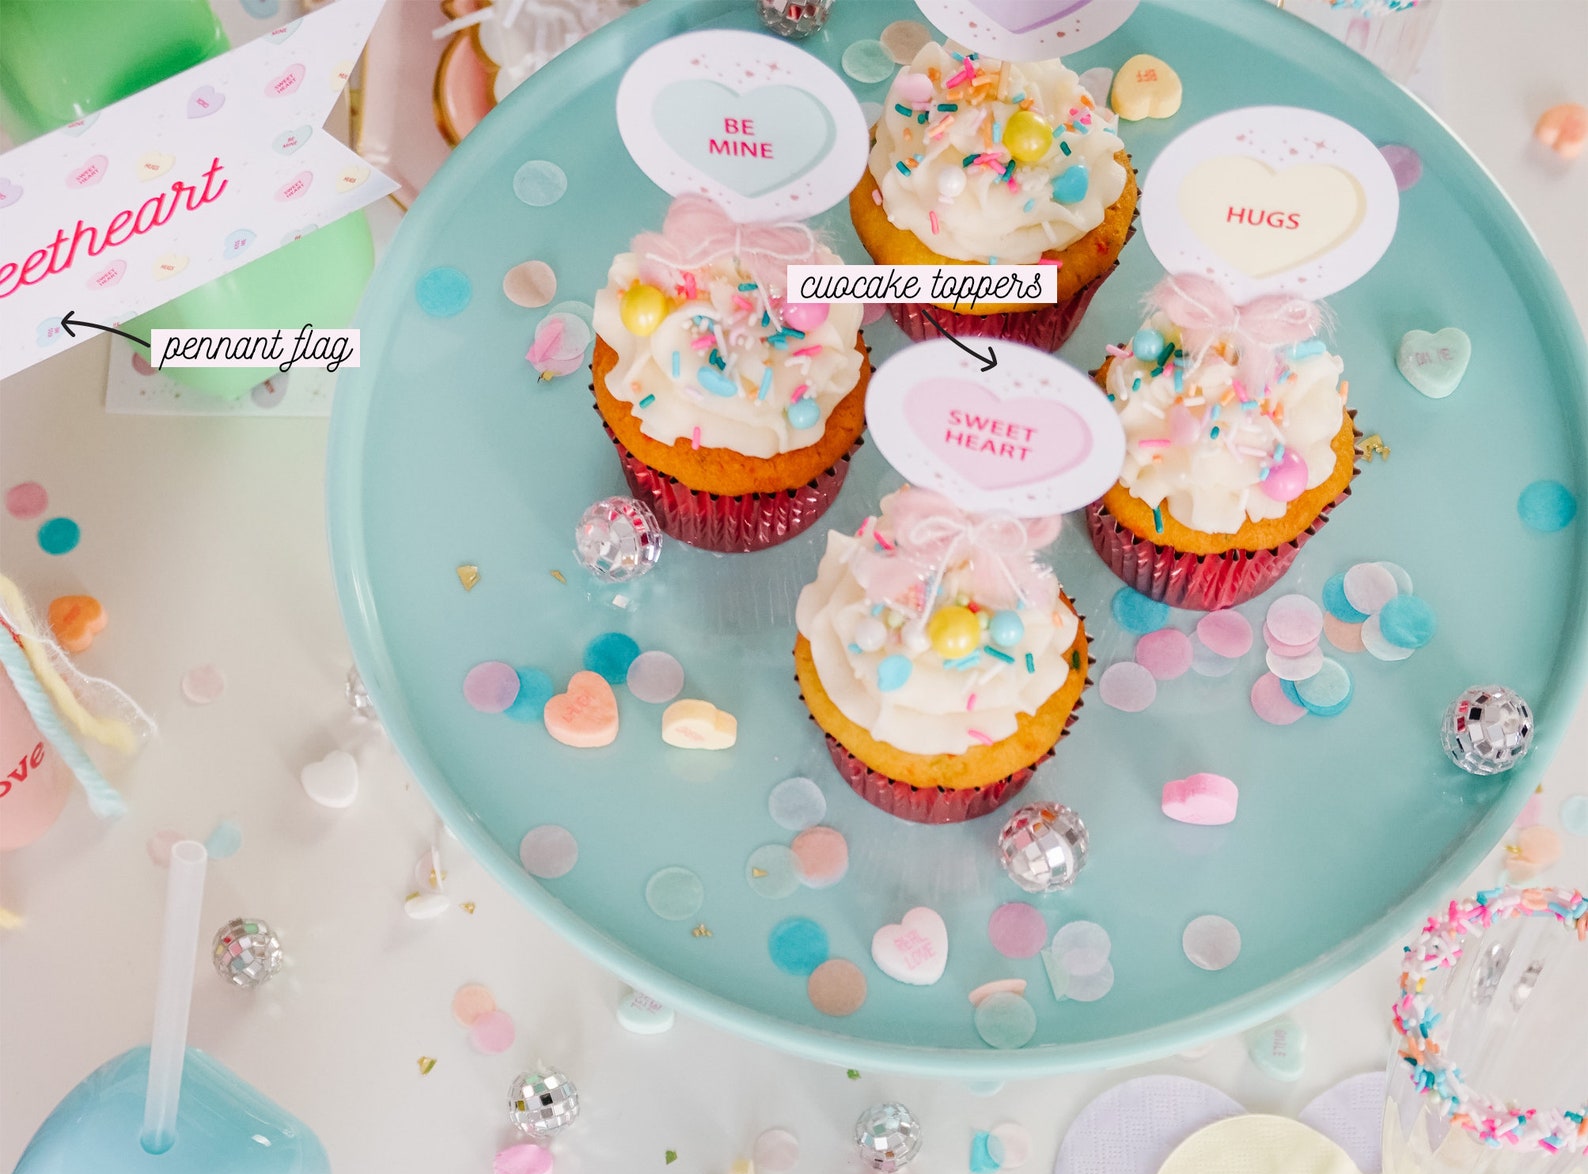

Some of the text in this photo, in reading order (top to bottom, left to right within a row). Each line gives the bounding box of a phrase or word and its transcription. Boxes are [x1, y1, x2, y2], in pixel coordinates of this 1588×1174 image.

[724, 117, 755, 136] BE
[709, 138, 774, 160] MINE
[1226, 206, 1301, 230] HUGS
[949, 408, 1039, 443] SWEET
[944, 429, 1034, 462] HEART
